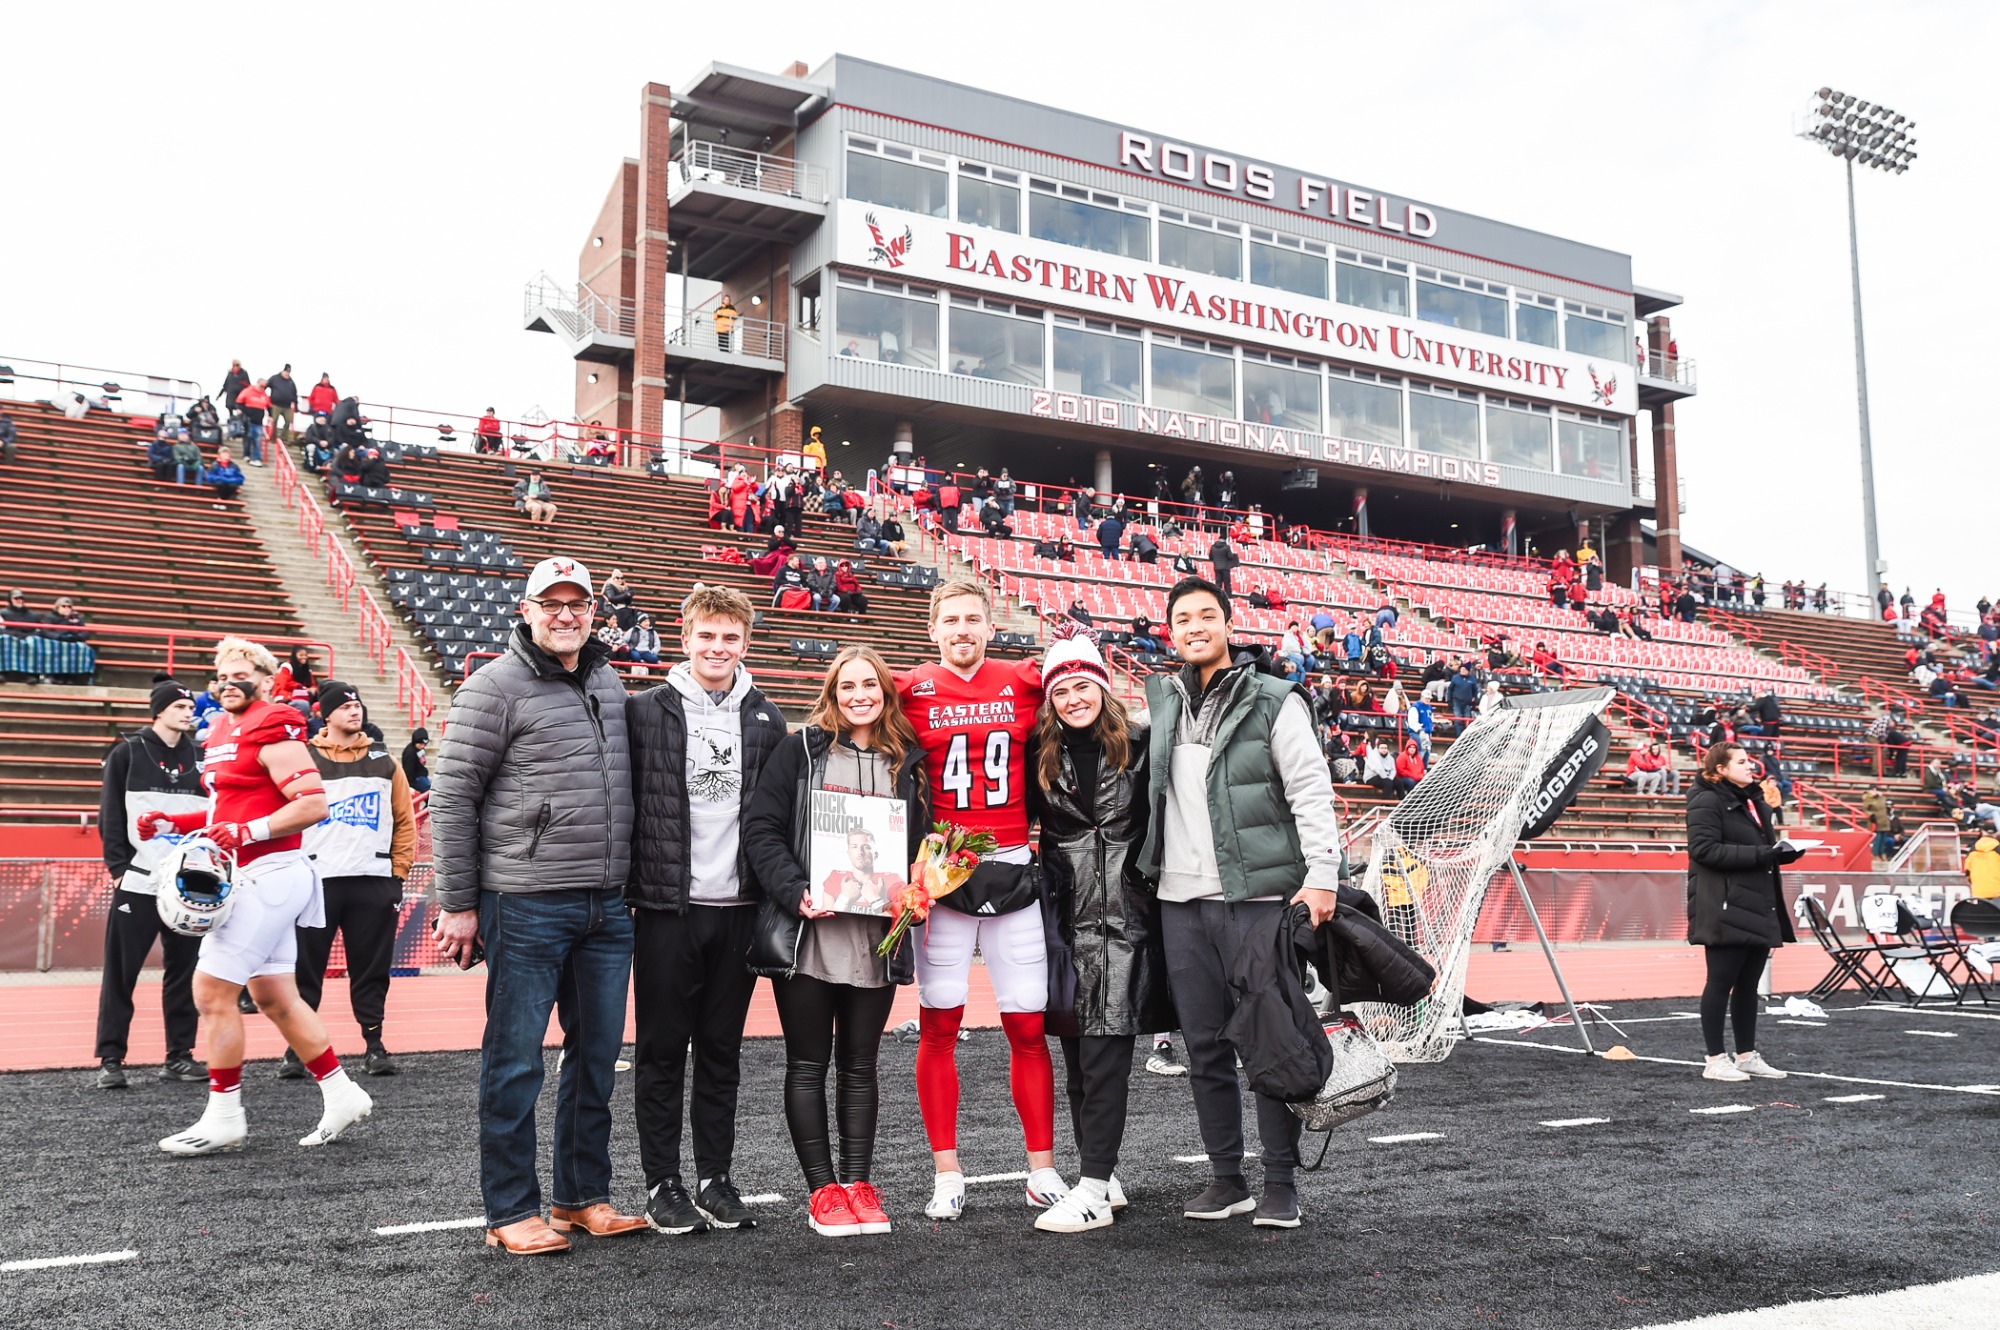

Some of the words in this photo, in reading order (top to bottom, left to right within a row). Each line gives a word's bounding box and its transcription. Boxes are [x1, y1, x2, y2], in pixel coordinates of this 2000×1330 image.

[1120, 130, 1275, 200] ROOS
[1300, 176, 1437, 238] FIELD
[946, 232, 1137, 303] EASTERN
[1144, 273, 1380, 352] WASHINGTON
[1387, 326, 1569, 389] UNIVERSITY
[1031, 390, 1119, 427] 2010
[1137, 407, 1311, 456] NATIONAL
[1322, 436, 1500, 486] CHAMPIONS
[928, 701, 1015, 720] EASTERN
[929, 714, 1015, 729] WASHINGTON
[942, 729, 1011, 811] 49
[1525, 735, 1598, 829] ROGERS
[329, 794, 379, 820] IGSKY
[813, 792, 846, 814] NICK
[813, 812, 863, 834] KOKICH
